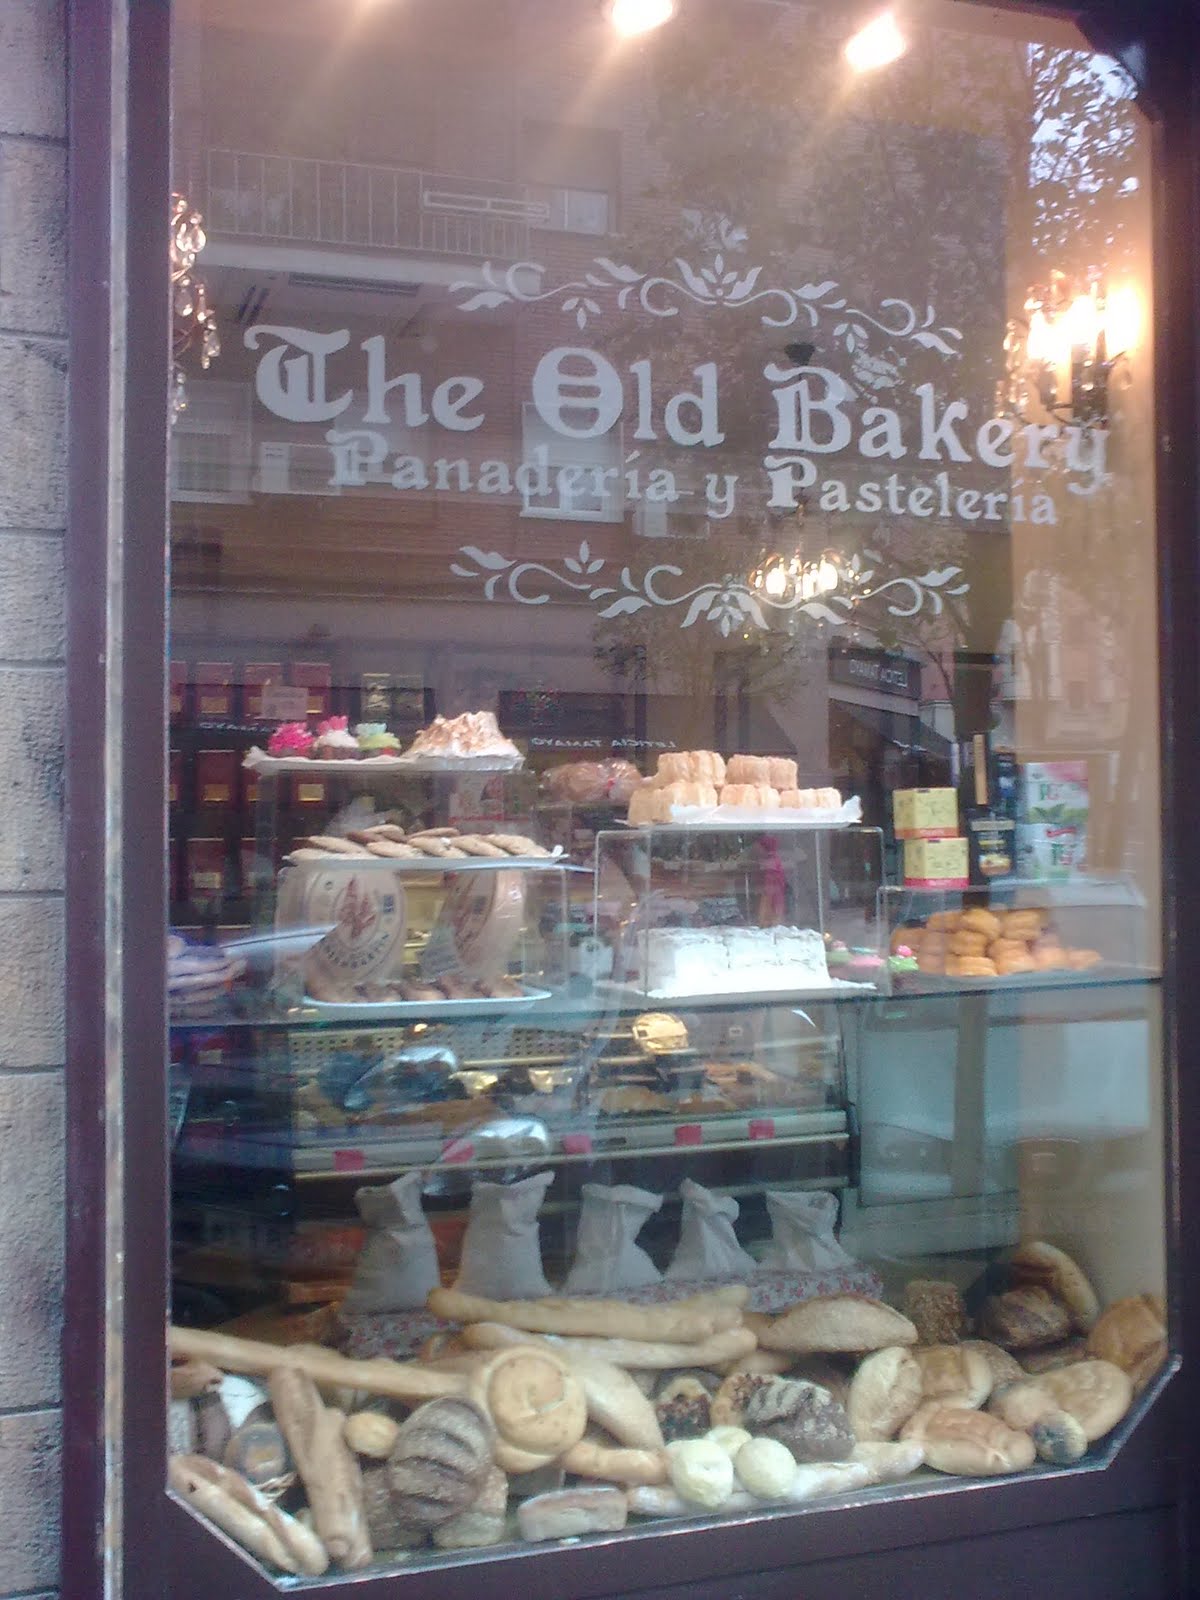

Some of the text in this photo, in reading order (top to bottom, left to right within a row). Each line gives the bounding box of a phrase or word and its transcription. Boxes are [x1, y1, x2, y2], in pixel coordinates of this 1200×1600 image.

[243, 325, 1110, 495] The Old Bakery
[326, 429, 1057, 525] Panadería y Pastelería
